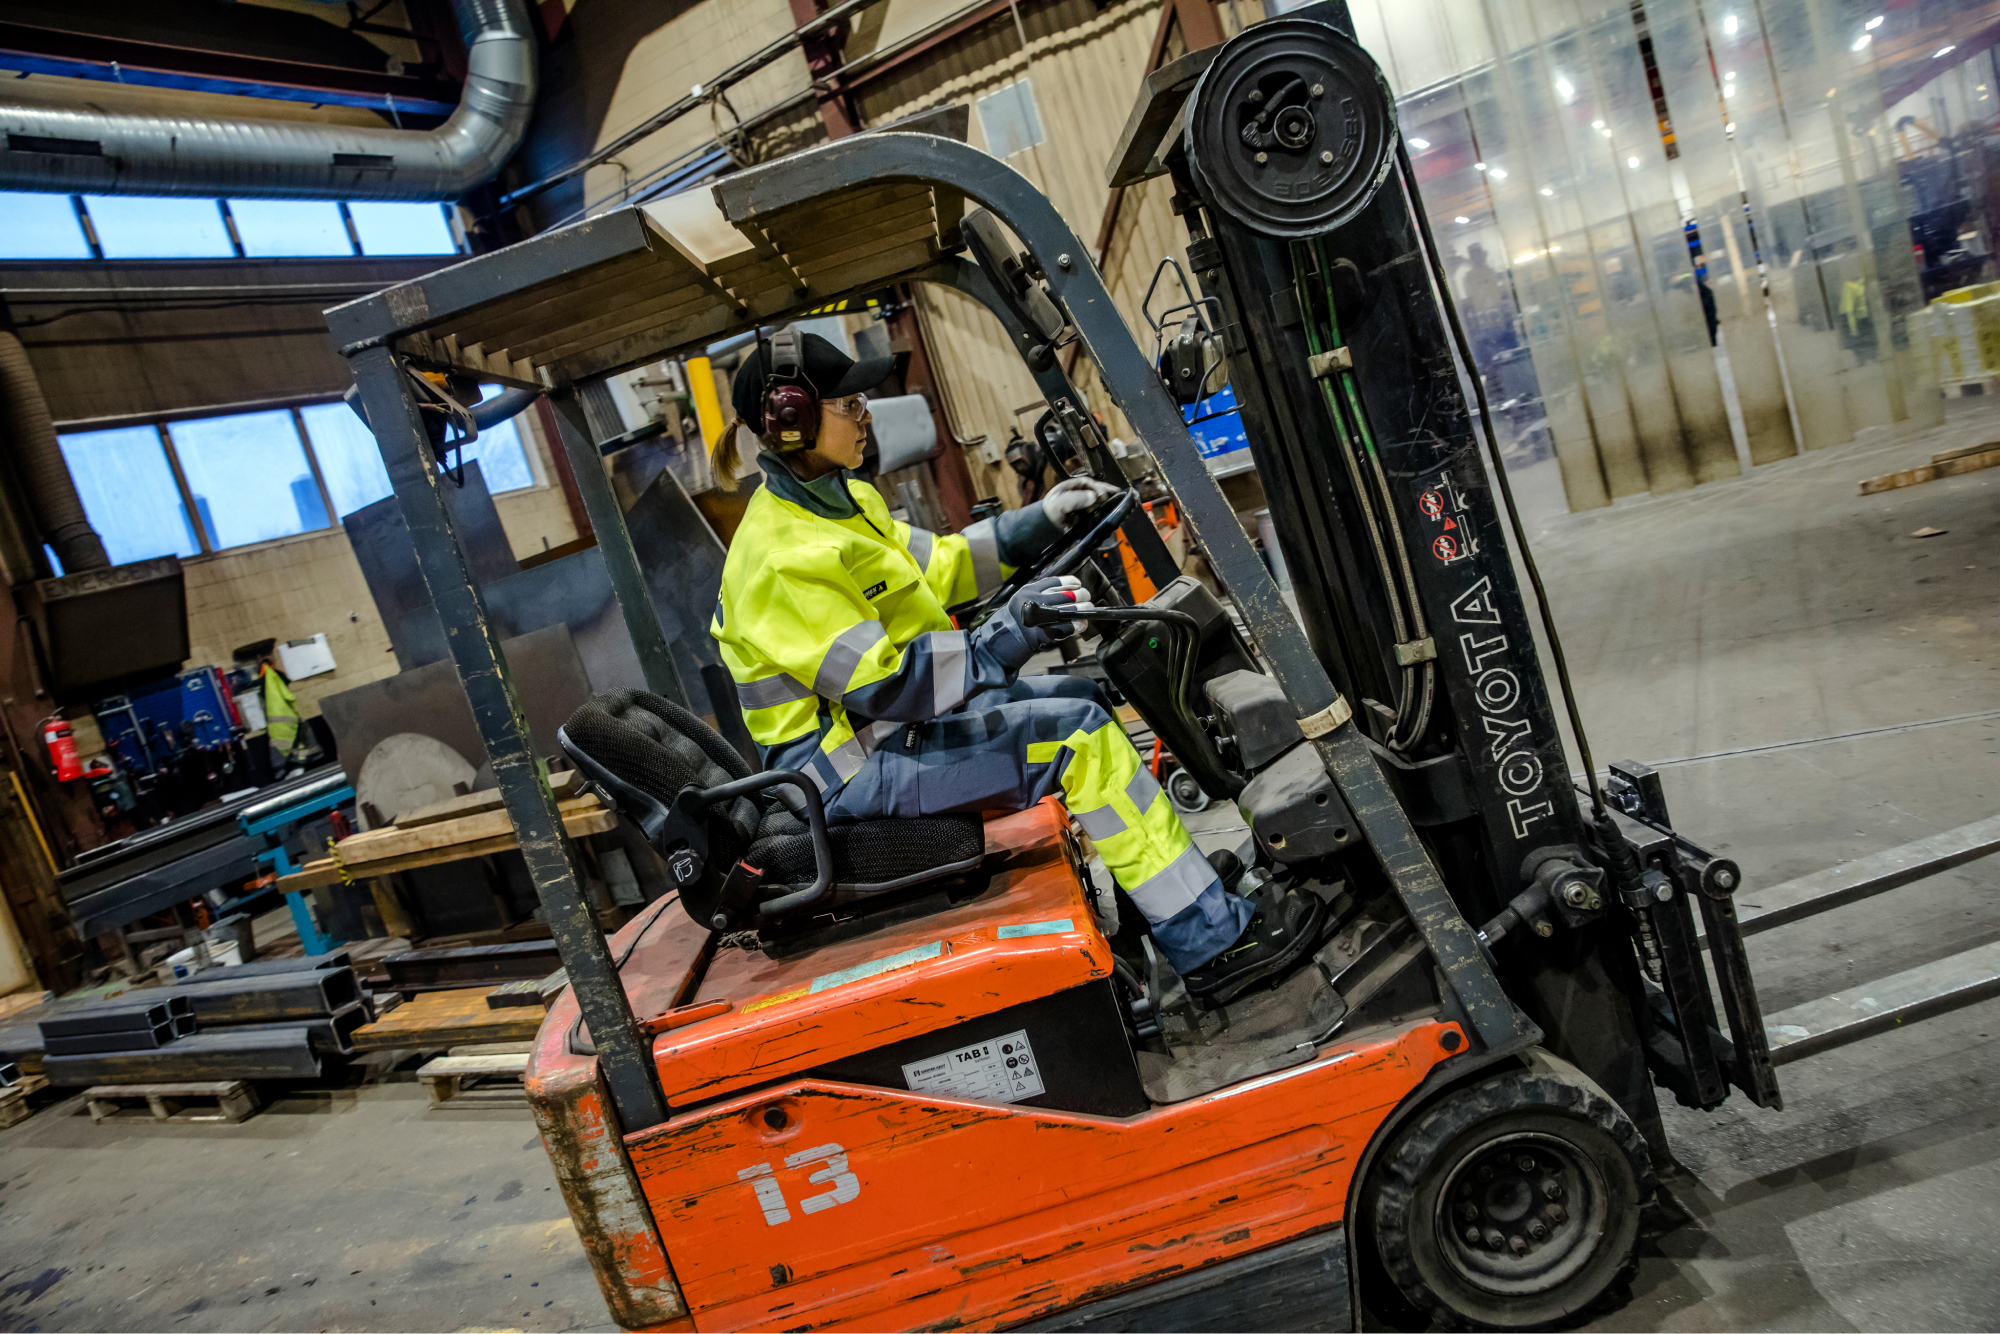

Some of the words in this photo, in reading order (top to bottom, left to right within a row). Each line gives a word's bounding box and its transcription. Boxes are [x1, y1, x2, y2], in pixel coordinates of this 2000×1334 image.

[1450, 576, 1554, 839] TOYOTA
[956, 1048, 981, 1063] TAB
[736, 1142, 860, 1226] 13
